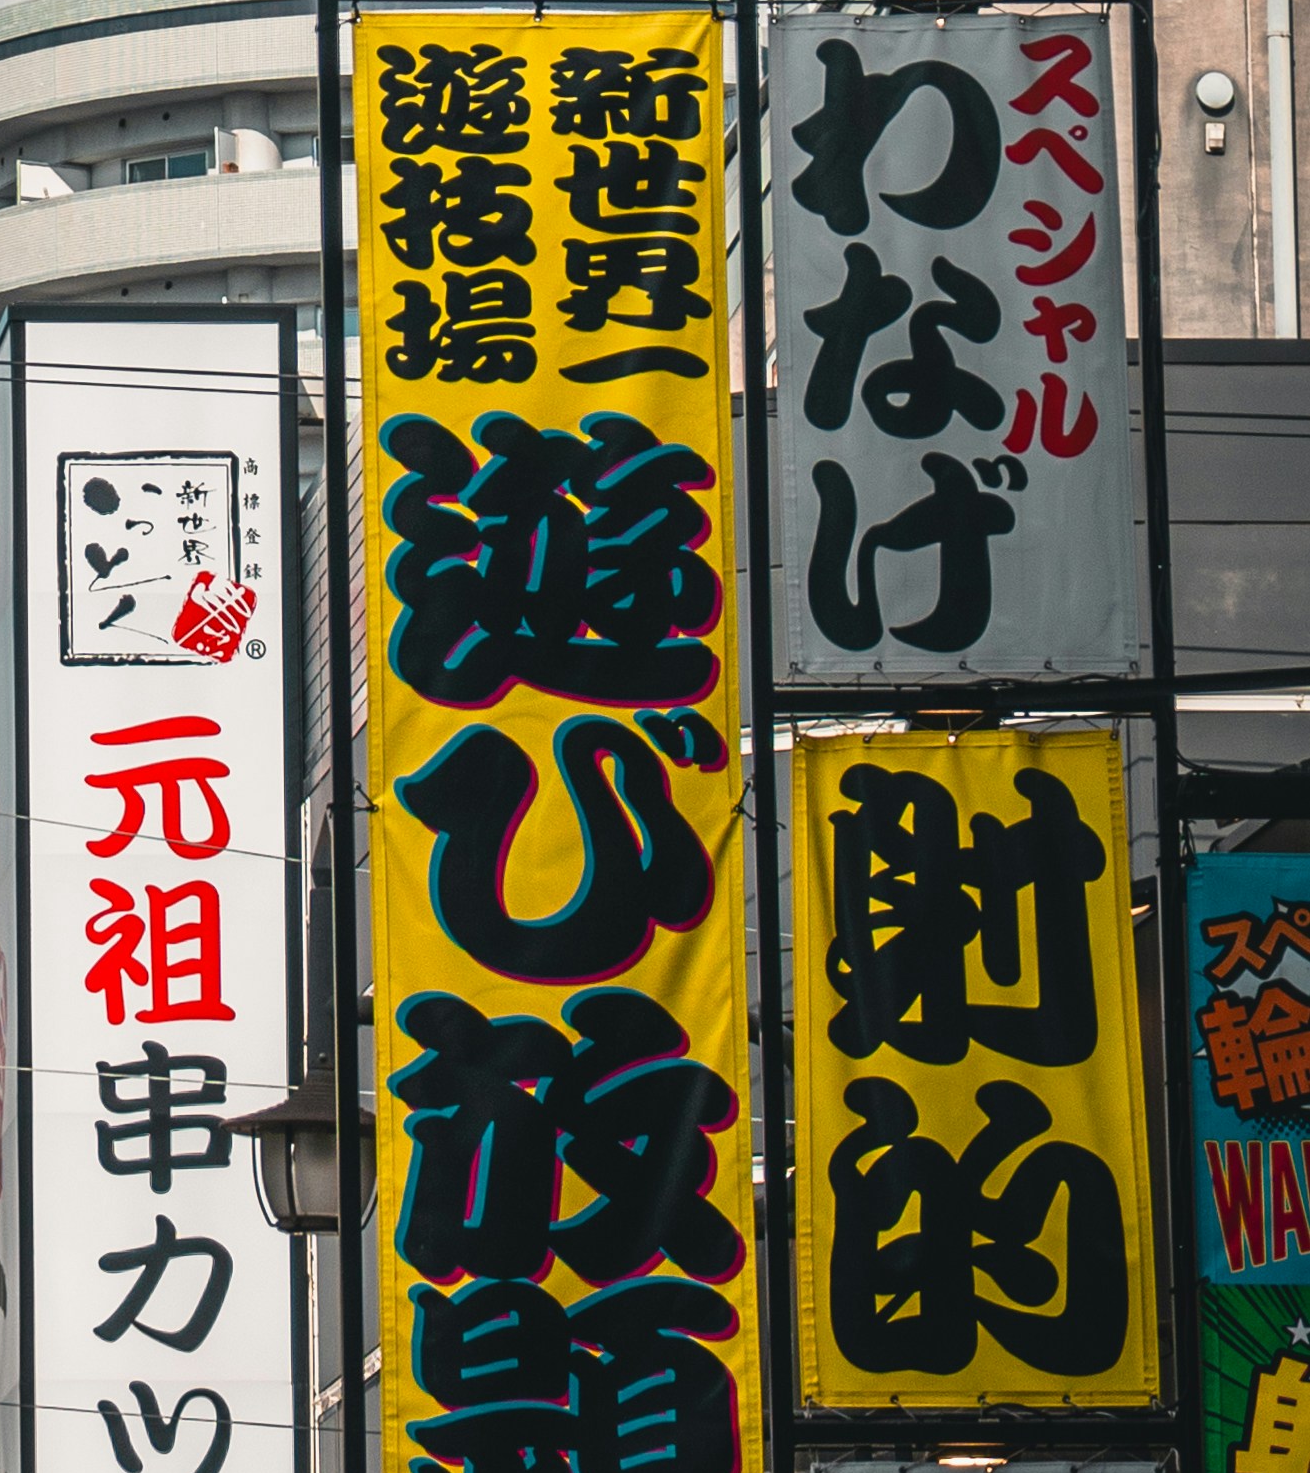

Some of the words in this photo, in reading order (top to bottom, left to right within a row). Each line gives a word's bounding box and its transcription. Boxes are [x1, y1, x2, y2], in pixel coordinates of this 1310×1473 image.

[377, 44, 538, 384] 遊技場
[550, 46, 713, 384] 新世界一
[789, 37, 1017, 653] わなげ
[1005, 33, 1103, 459] スペシャル
[827, 759, 1128, 1379] 射的
[1204, 1139, 1310, 1274] WA
